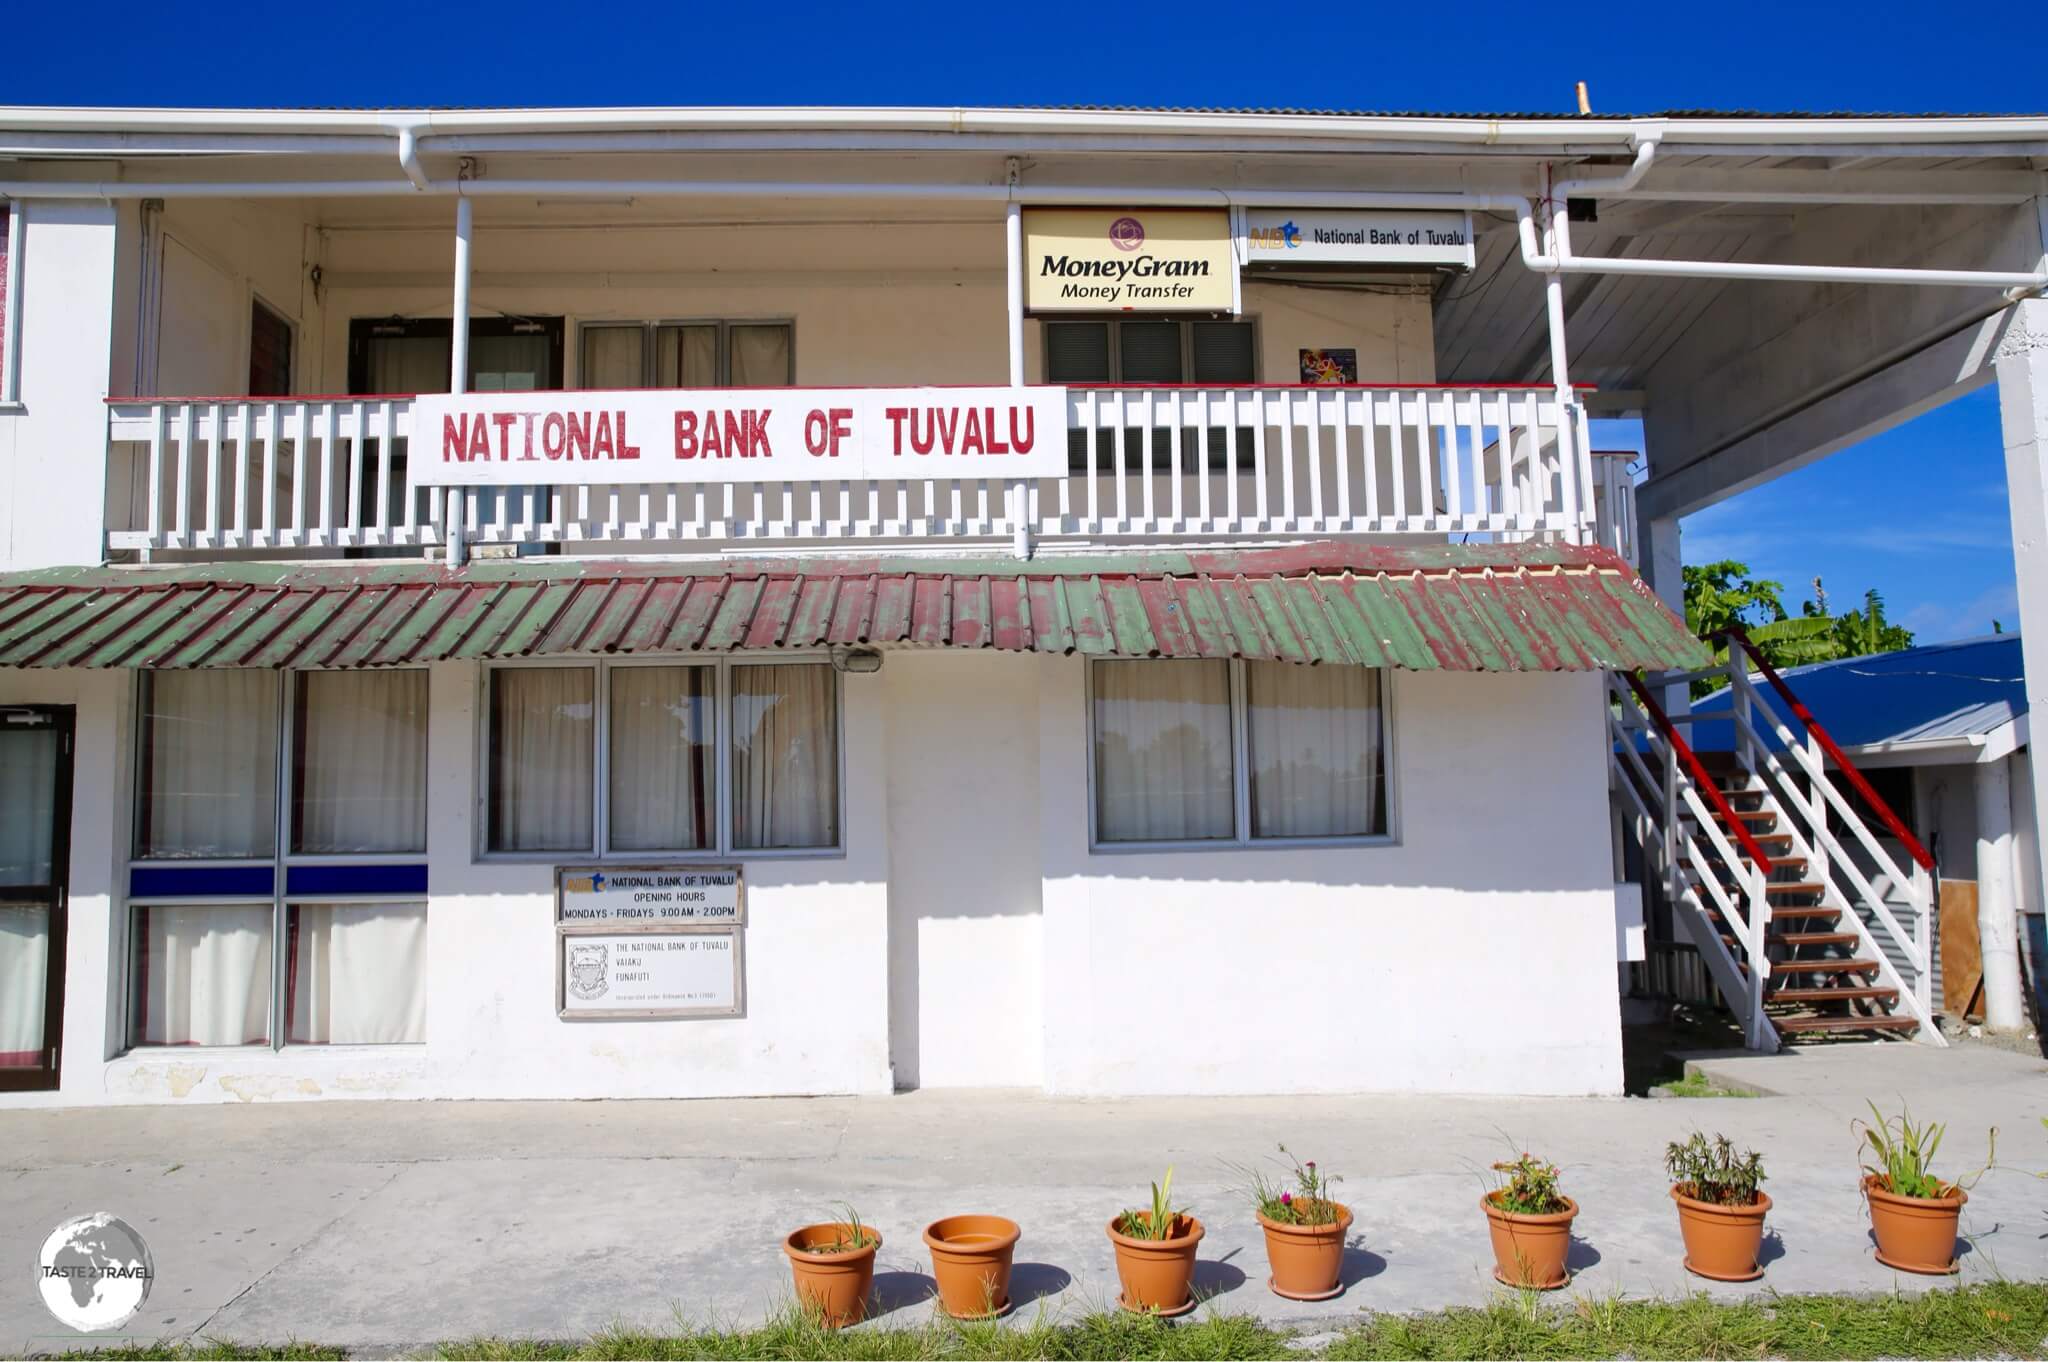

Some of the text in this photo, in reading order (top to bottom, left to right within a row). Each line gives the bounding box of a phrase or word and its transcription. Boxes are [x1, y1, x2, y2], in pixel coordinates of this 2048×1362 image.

[1314, 229, 1364, 244] National
[1370, 229, 1400, 245] Bank
[1407, 229, 1419, 245] of
[1426, 230, 1465, 245] Tuvalu
[1040, 255, 1209, 281] MoneyGram
[1060, 283, 1195, 302] Money Transfer
[442, 406, 1034, 462] NATIONAL BANK OF TUVALU
[612, 877, 654, 887] NATIONAL
[658, 876, 681, 886] BANK
[685, 876, 696, 886] OF
[700, 875, 734, 886] TUVALU
[634, 892, 705, 902] OPENING HOURS
[565, 909, 607, 919] MONDAYS
[616, 908, 654, 918] FRIDAYS
[616, 941, 729, 952] THE NATIONAL BANK OF TUVALU
[616, 973, 650, 982] FUNAFUTI
